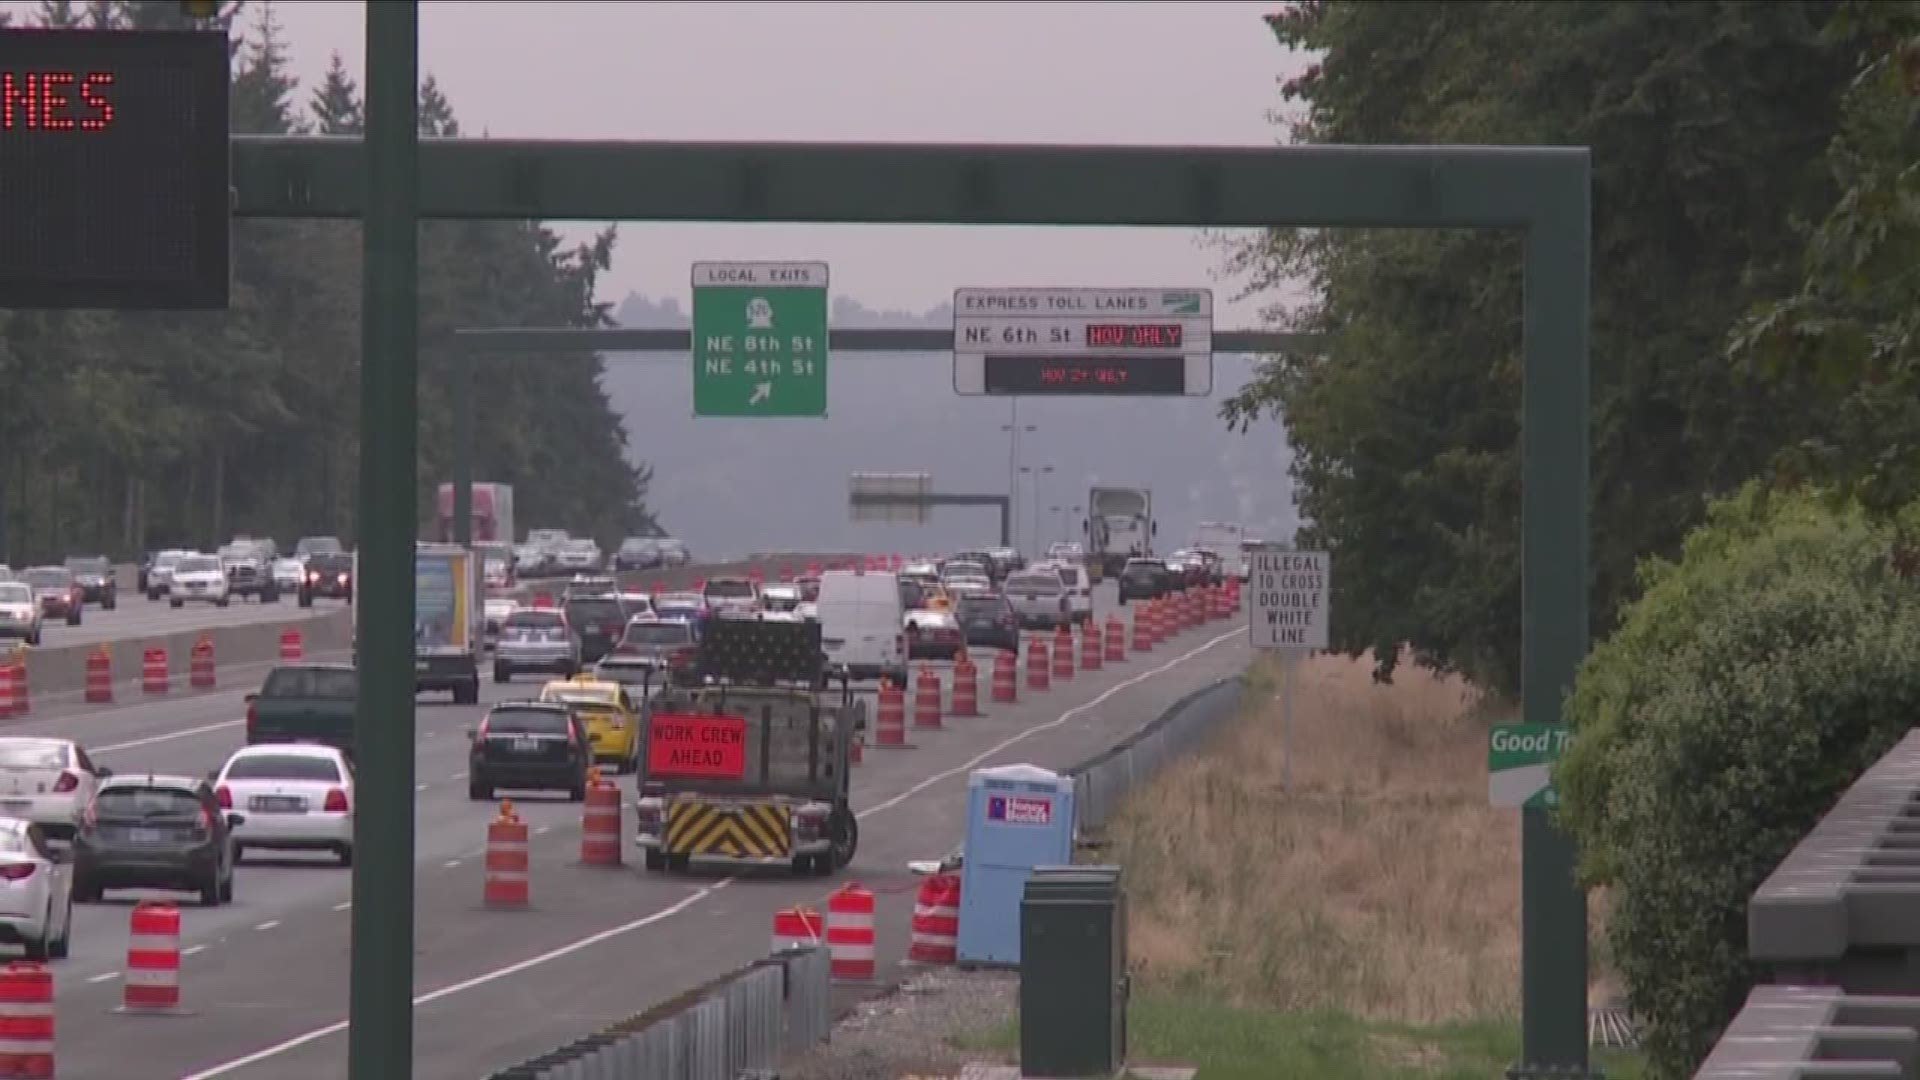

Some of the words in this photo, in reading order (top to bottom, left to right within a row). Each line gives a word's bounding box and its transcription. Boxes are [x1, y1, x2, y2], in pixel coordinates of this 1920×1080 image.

[708, 269, 757, 282] LOCAL
[770, 269, 810, 282] EXITS
[965, 295, 1039, 310] EXPRESS
[1048, 295, 1088, 310] TOLL
[1095, 296, 1148, 310] LANES
[966, 326, 991, 342] NE
[1002, 326, 1038, 342] 6th
[1050, 326, 1070, 342] St
[706, 336, 733, 352] NE
[744, 335, 780, 352] 8th
[791, 336, 814, 352] St
[705, 359, 733, 374] NE
[743, 359, 781, 374] 4th
[791, 359, 814, 375] St
[1258, 555, 1322, 572] ILLEGAL
[1258, 574, 1274, 590] TO
[1281, 574, 1322, 590] CROSS
[1259, 592, 1321, 608] DOUBLE
[1267, 610, 1312, 625] WHITE
[1272, 628, 1306, 644] LINE
[653, 724, 694, 741] WORK
[700, 726, 744, 744] CREW
[1491, 729, 1551, 752] Good
[669, 748, 723, 767] AHEAD
